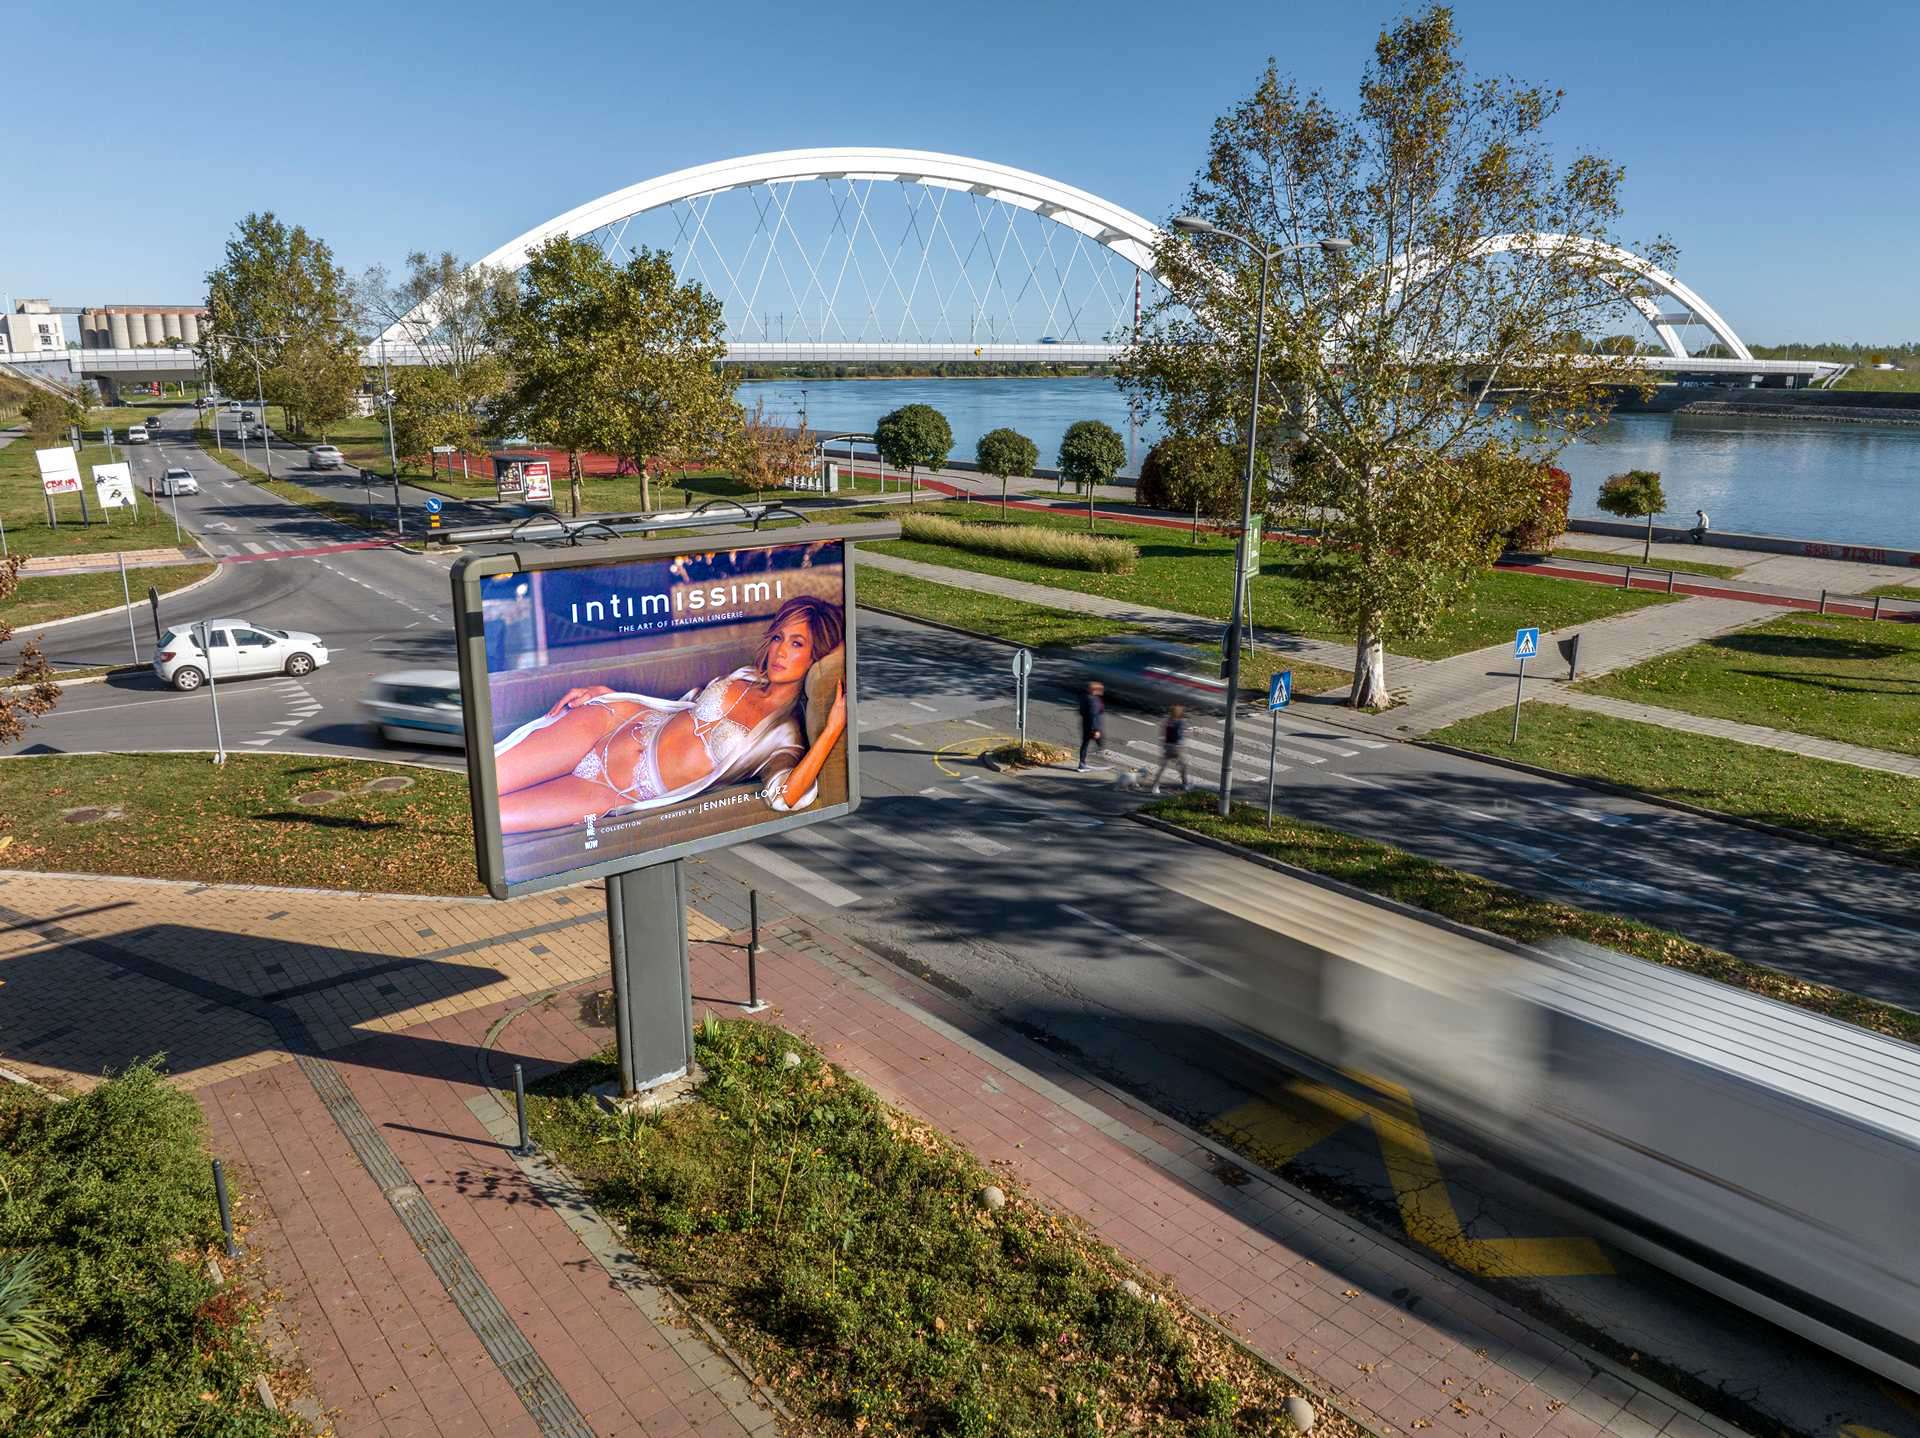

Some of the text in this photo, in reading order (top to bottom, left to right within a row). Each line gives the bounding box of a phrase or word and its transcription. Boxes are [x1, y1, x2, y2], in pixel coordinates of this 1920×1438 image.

[571, 580, 783, 624] intimissimi
[618, 610, 744, 633] THE ART OF ITALIAN LINGERIE
[699, 794, 750, 814] JENNIFER
[601, 820, 641, 833] COLLECTION
[584, 839, 599, 850] NOW
